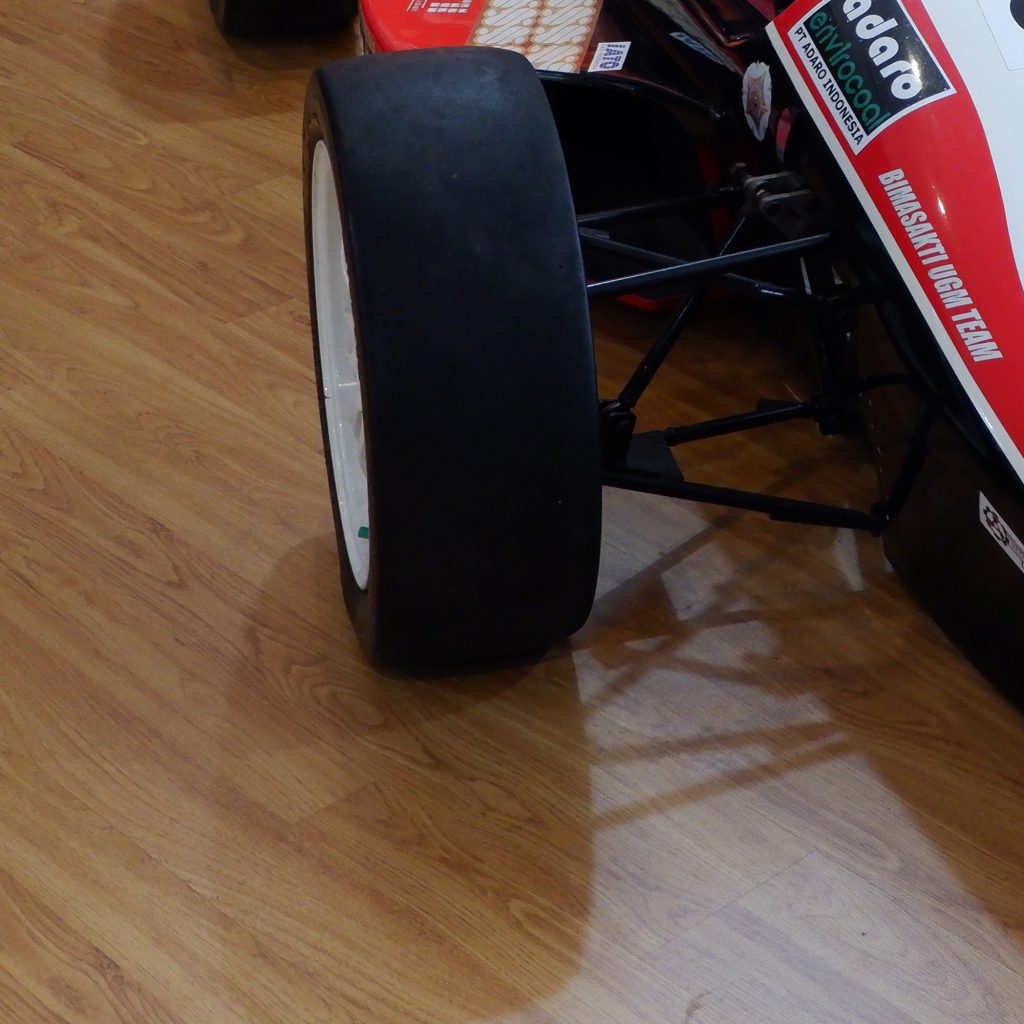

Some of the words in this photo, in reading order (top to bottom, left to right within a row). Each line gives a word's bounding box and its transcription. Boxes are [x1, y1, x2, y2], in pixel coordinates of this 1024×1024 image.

[793, 26, 807, 44] PT
[801, 42, 828, 80] ADARO
[822, 78, 864, 146] INDONESIA
[809, 11, 894, 131] envirocoal
[878, 168, 949, 266] BIMASAKTI
[927, 263, 974, 309] UGM
[951, 307, 1004, 363] TEAM
